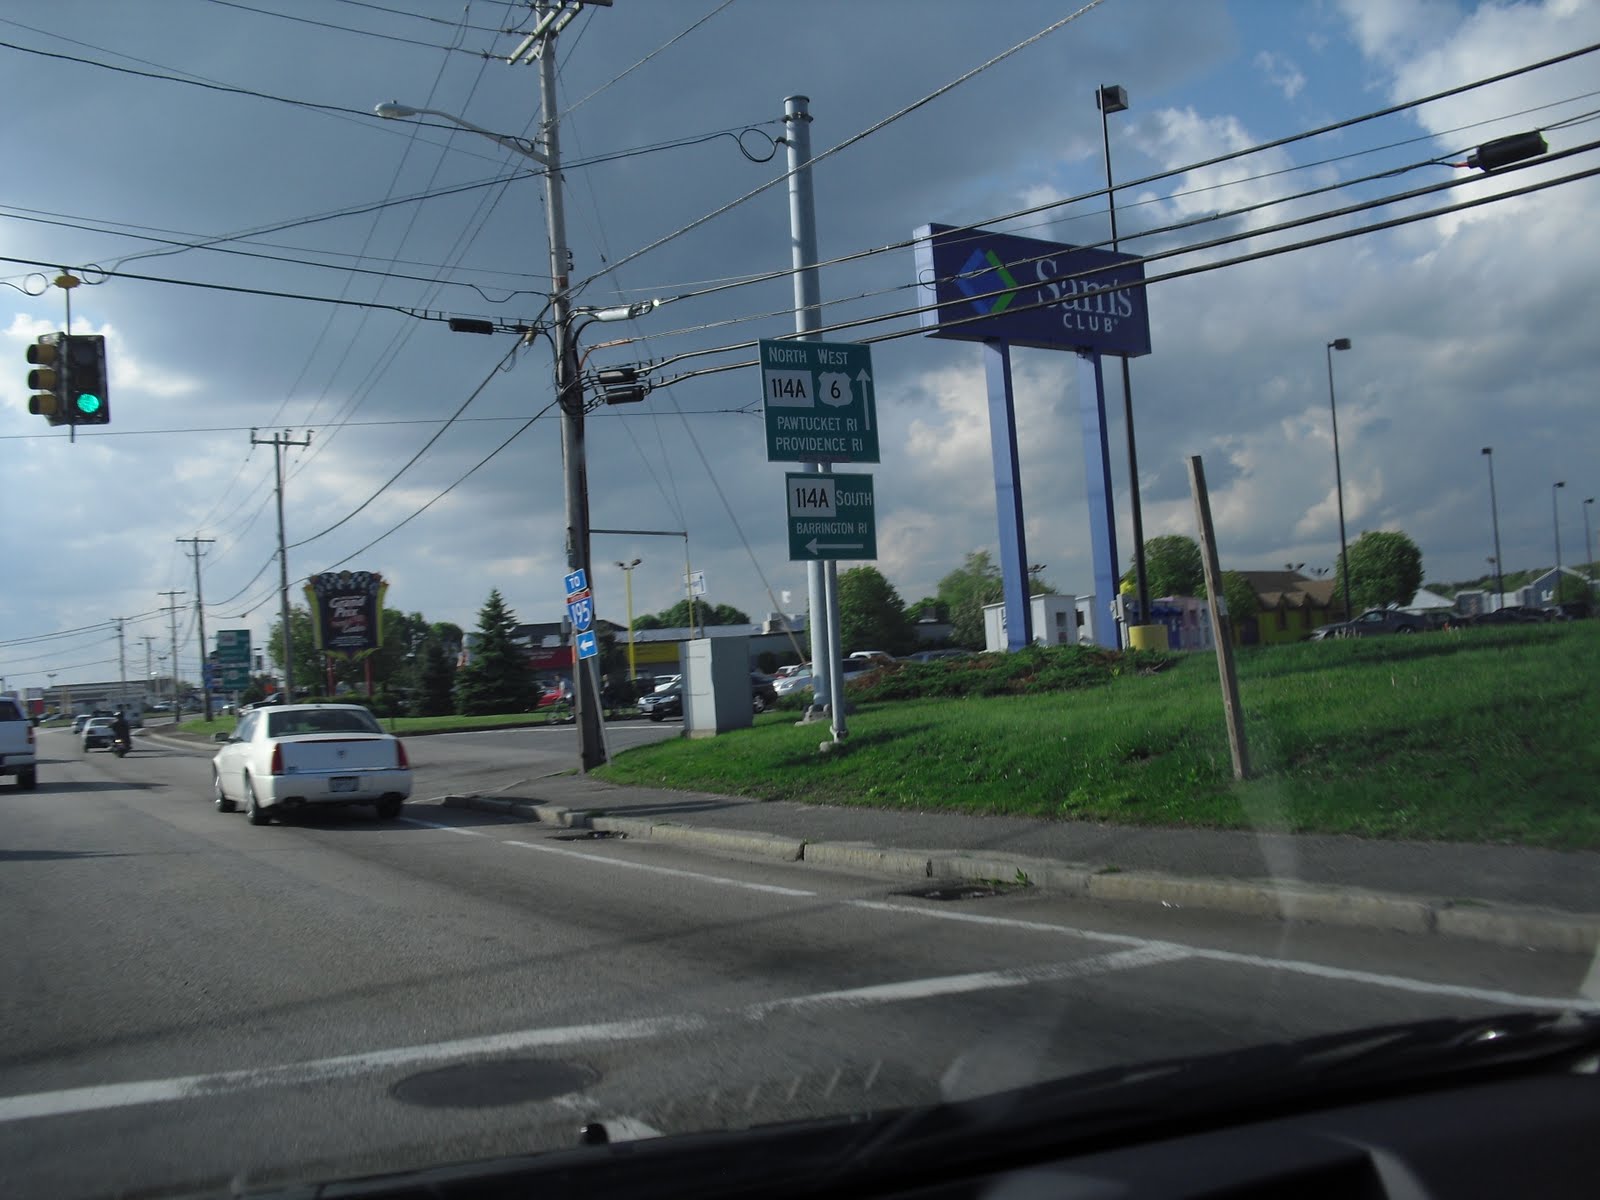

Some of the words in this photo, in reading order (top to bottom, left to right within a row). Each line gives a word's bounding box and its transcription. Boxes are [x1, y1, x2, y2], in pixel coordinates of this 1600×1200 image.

[1063, 312, 1113, 333] CLUB
[768, 346, 807, 364] NORTH
[817, 348, 849, 365] WEST
[771, 378, 807, 399] 114A
[830, 379, 841, 399] 6
[777, 416, 841, 431] PAWTUCKET
[846, 418, 858, 432] RI
[775, 436, 847, 451] PROVIDENCE
[851, 438, 863, 452] RI
[795, 487, 830, 508] 114A
[835, 490, 872, 506] SOUTH
[796, 522, 854, 535] BARRINGTON
[858, 523, 868, 535] RI
[568, 575, 581, 589] TO
[570, 600, 590, 625] 195
